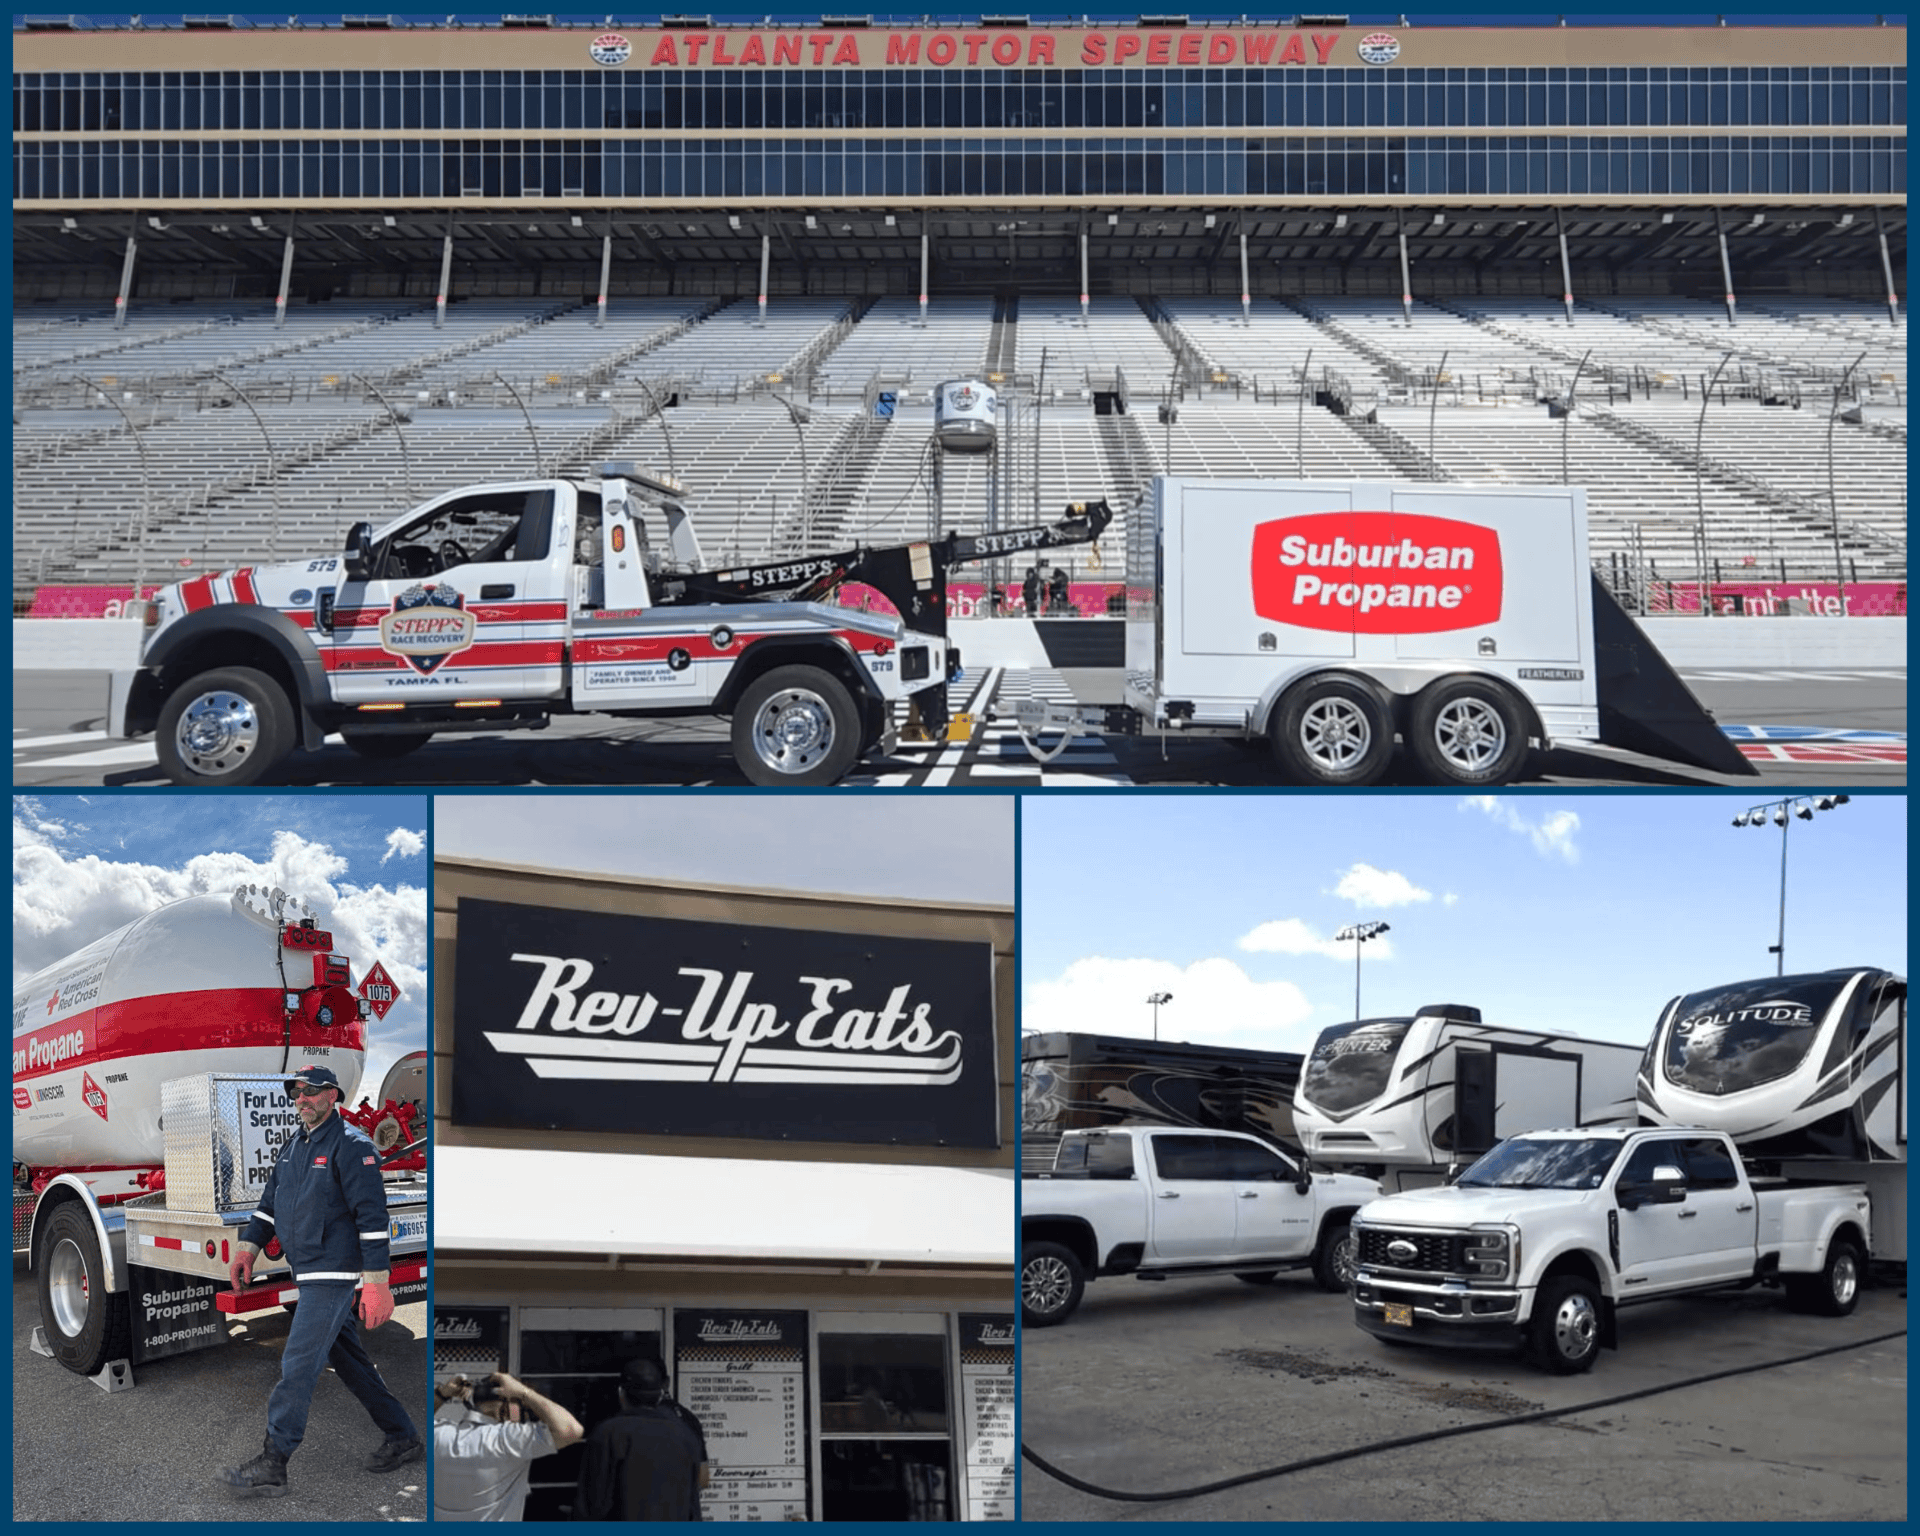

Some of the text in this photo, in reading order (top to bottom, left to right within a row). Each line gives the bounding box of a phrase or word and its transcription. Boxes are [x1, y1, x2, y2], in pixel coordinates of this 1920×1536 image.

[650, 33, 1339, 66] ATLANTA MOTOR SPEEDWAY
[974, 527, 1059, 554] STEPP'
[1278, 535, 1474, 570] Suburban
[751, 558, 838, 586] STEPP'S
[391, 616, 465, 635] STEPP'S
[390, 634, 465, 644] RACE RECOVERY
[386, 677, 440, 686] TAMPA
[1519, 669, 1583, 680] FEATHERLITE
[62, 971, 104, 997] American
[369, 985, 391, 1001] 1075
[58, 986, 99, 1012] Red Cross
[377, 1003, 384, 1012] 2
[510, 952, 953, 1082] Rev-Up Eats
[1676, 1008, 1812, 1034] SOLITUDE
[29, 1029, 84, 1070] Propane
[302, 1046, 330, 1057] PROPANE
[1315, 1038, 1392, 1057] SPRINTER
[105, 1072, 129, 1084] PROPANE
[243, 1091, 296, 1109] For Loc
[141, 1283, 214, 1308] Suburban
[146, 1299, 210, 1322] Propane
[143, 1323, 217, 1348] 1-800-PROPANE
